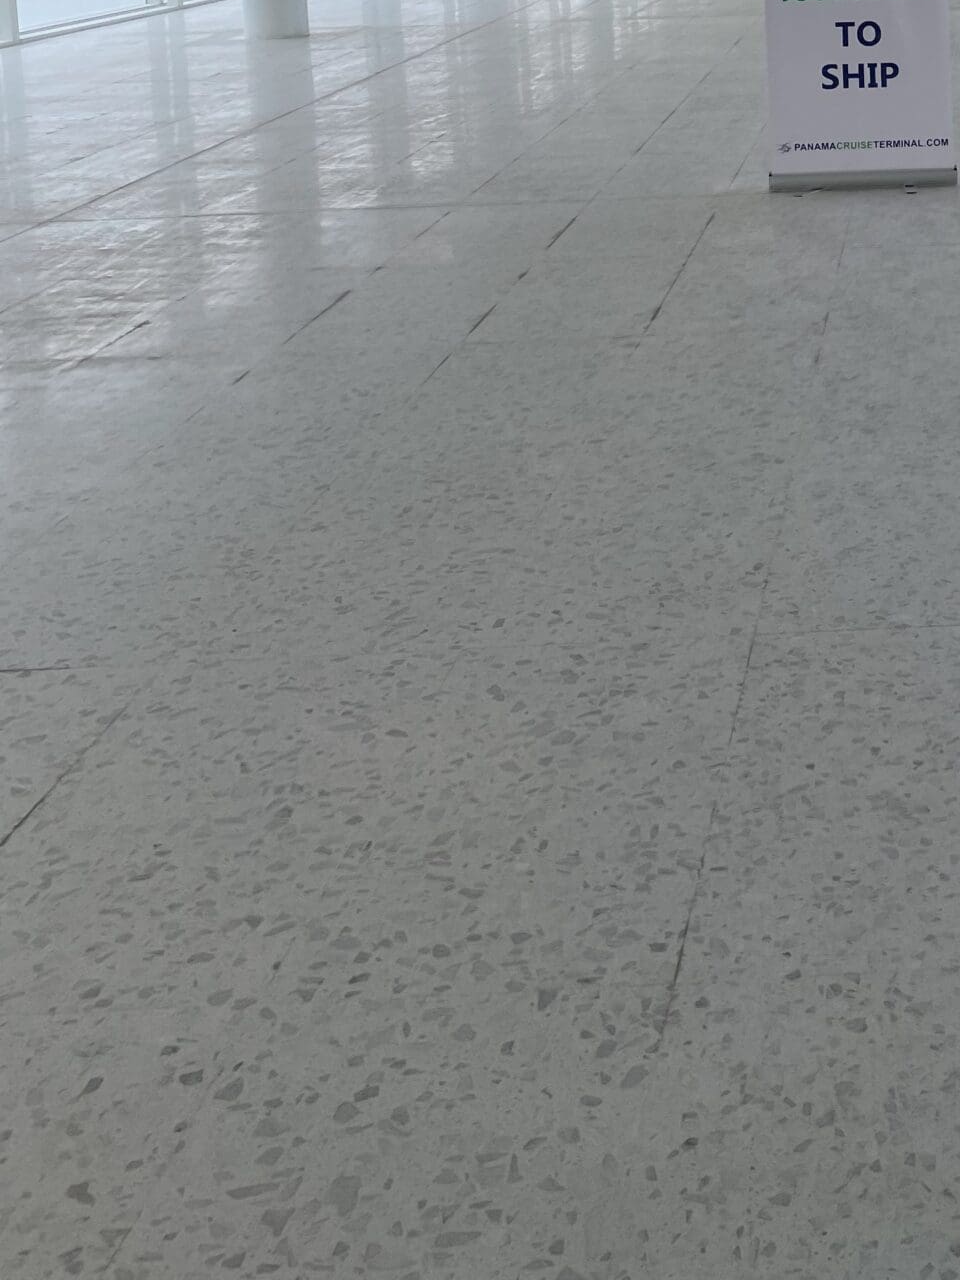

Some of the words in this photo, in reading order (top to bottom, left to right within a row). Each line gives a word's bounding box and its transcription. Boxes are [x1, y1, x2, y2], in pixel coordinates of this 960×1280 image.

[835, 20, 882, 47] TO
[821, 62, 900, 90] SHIP
[794, 138, 949, 152] PANAMACRUISETERMINAL.COM
